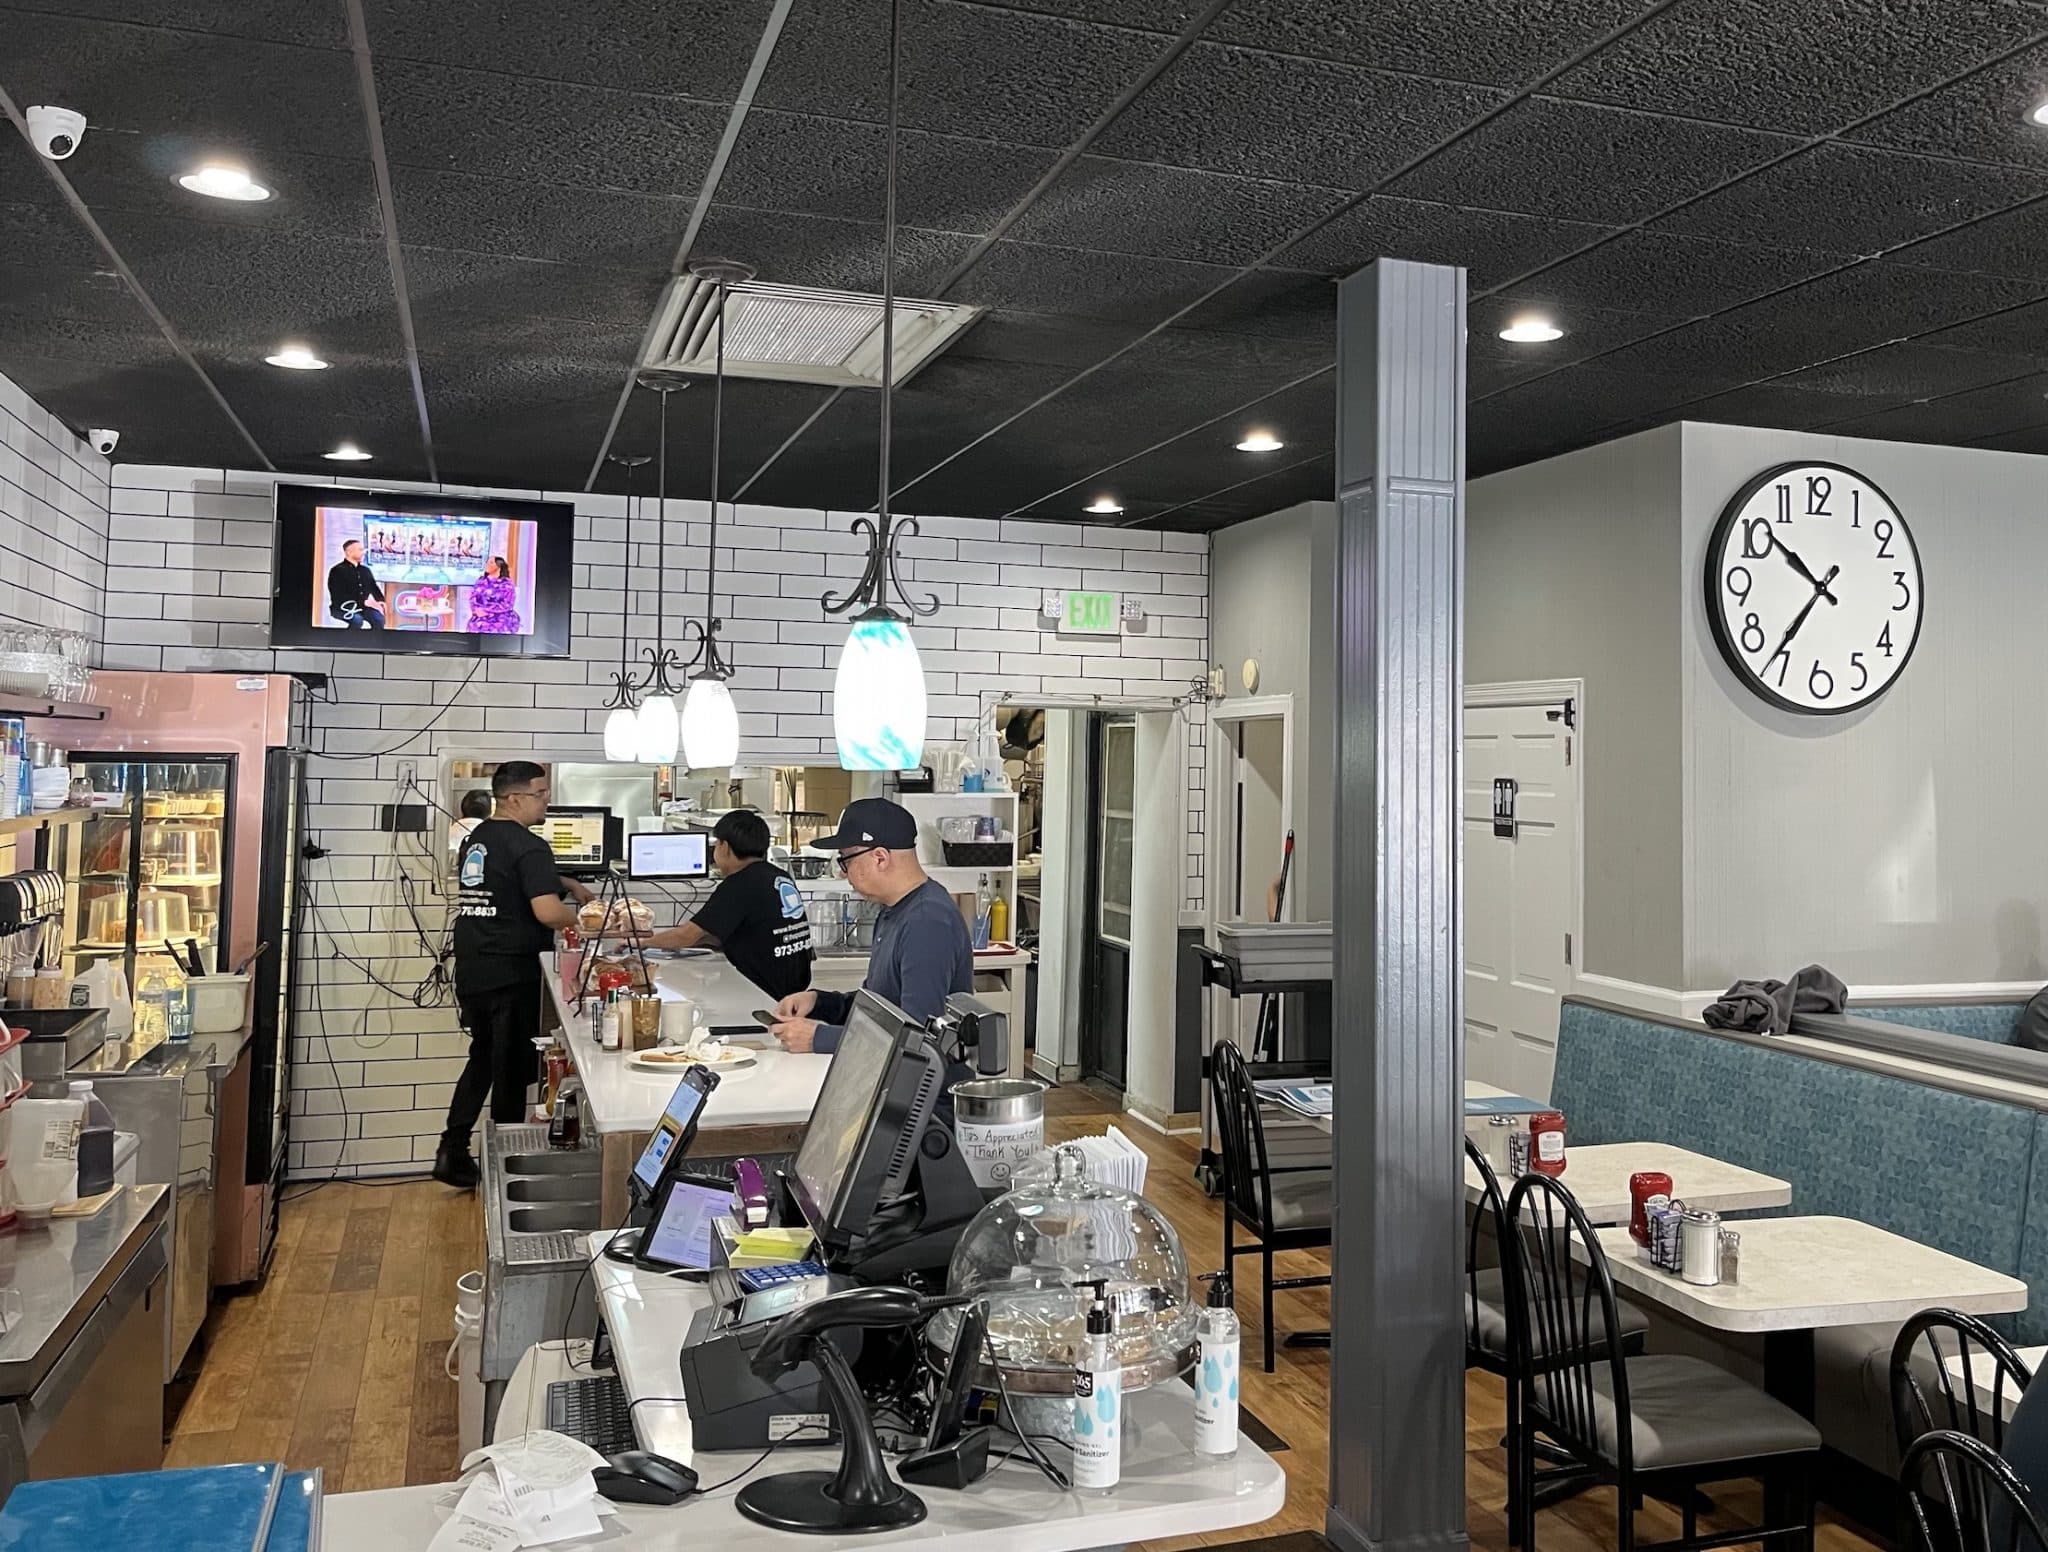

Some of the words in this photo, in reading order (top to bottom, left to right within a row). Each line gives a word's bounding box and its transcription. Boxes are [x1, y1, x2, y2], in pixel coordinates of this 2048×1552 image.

[1776, 485, 1793, 523] 11
[1805, 476, 1832, 516] 12
[1851, 490, 1861, 528] 1
[1741, 517, 1775, 559] 10
[1874, 519, 1895, 558] 2
[1726, 566, 1752, 607] 9
[1892, 571, 1910, 611] 3
[1068, 593, 1114, 629] EXIT
[1741, 612, 1765, 653] 8
[1875, 619, 1893, 657] 4
[1774, 650, 1790, 687] 7
[1809, 659, 1834, 699] 6
[1850, 652, 1868, 691] 5
[968, 1144, 1005, 1159] Thank
